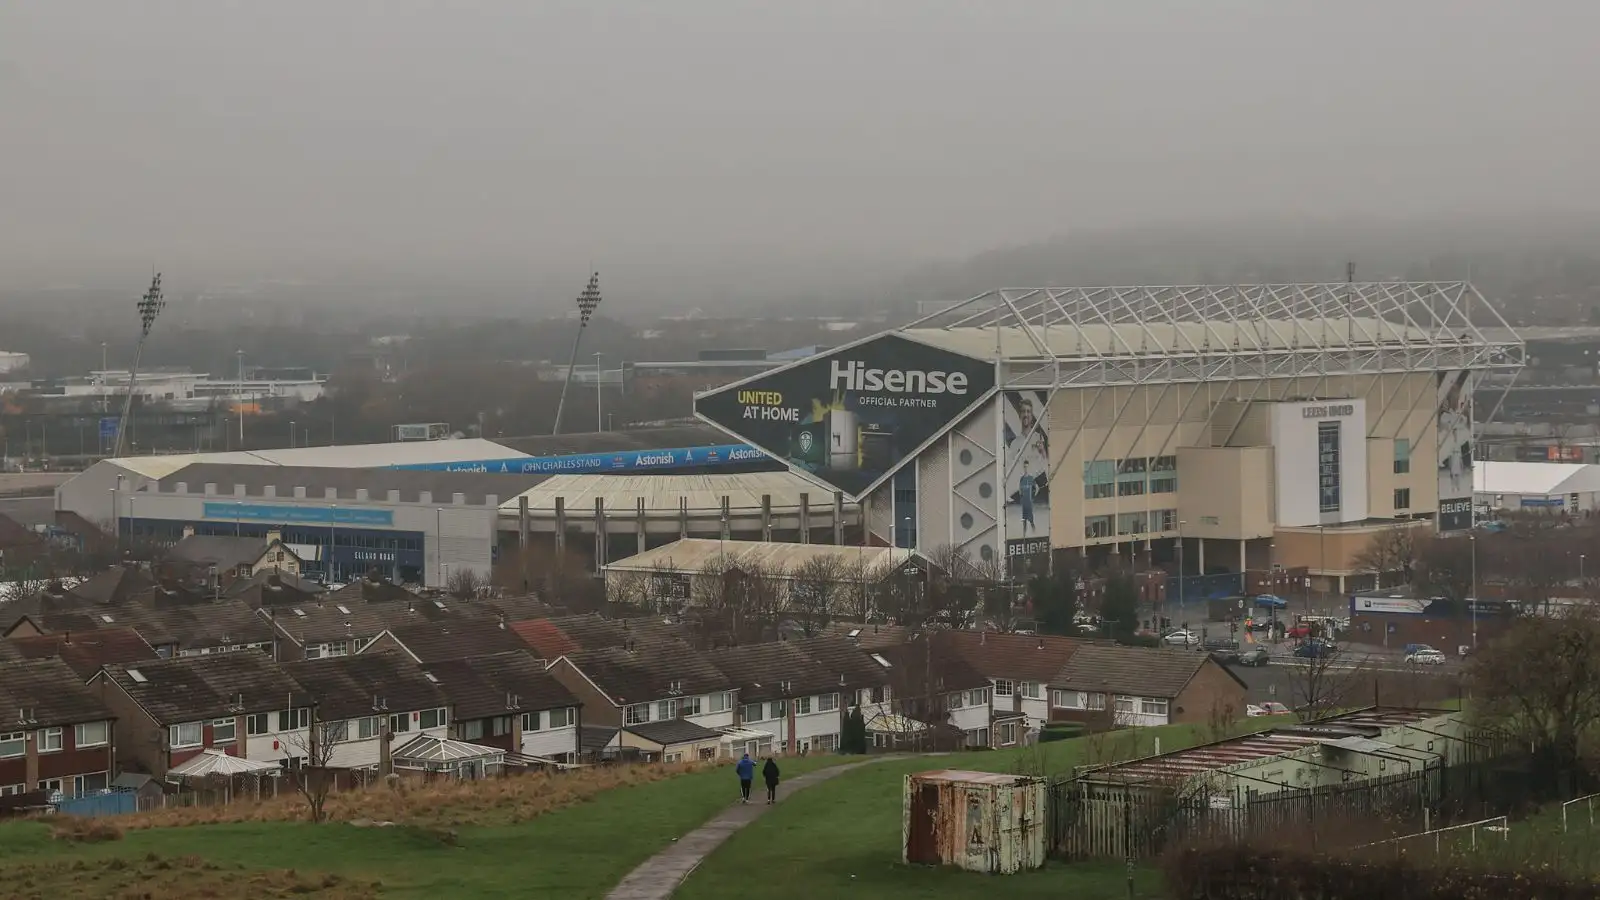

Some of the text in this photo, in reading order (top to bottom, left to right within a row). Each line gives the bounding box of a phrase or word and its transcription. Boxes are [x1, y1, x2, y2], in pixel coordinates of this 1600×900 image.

[830, 359, 968, 395] Hisense
[738, 391, 782, 406] UNITED
[859, 396, 937, 409] OFFICIAL PARTNER
[743, 406, 799, 422] AT HOME
[635, 451, 674, 466] Astonish
[522, 462, 541, 475] JOHN
[542, 459, 576, 472] CHARLES
[577, 458, 601, 469] STAND
[1441, 502, 1471, 514] BELIEVE
[354, 551, 395, 561] ELLAND ROAD
[1009, 541, 1049, 556] BELIEVE
